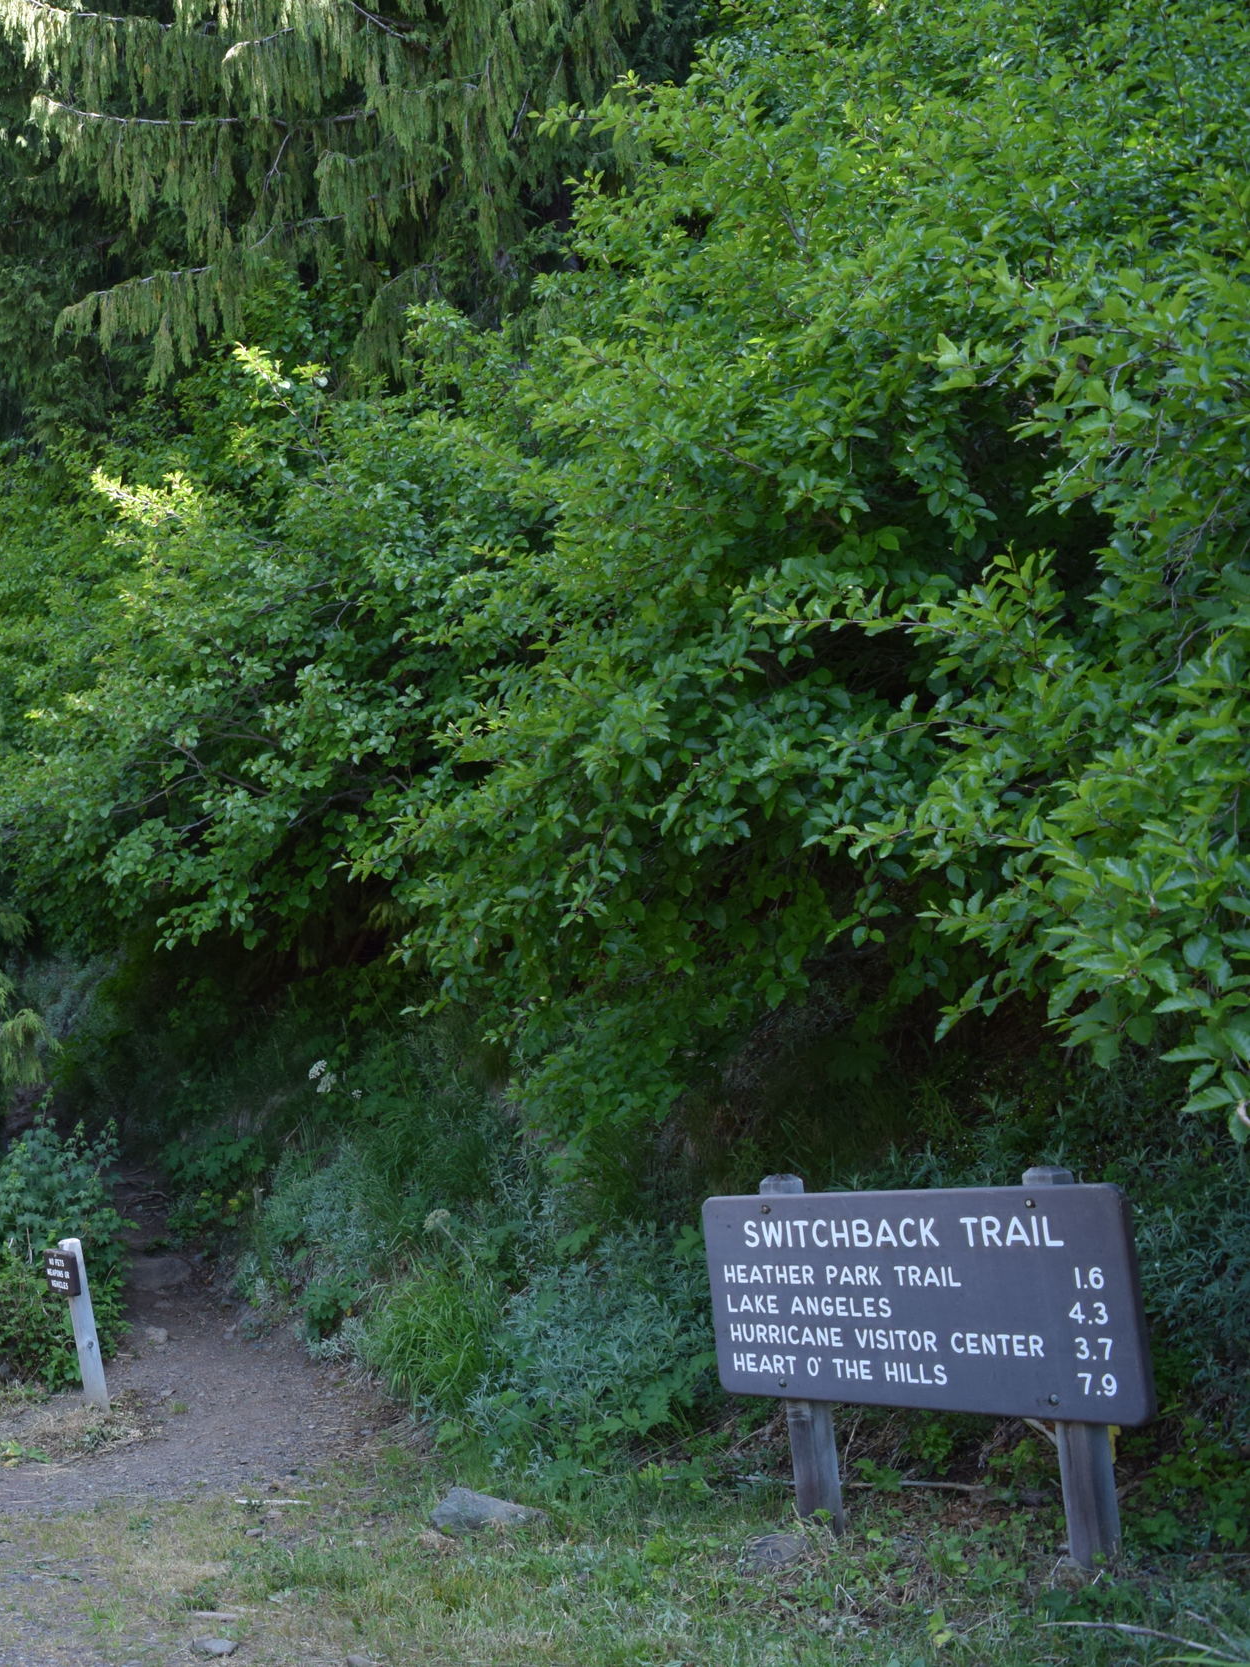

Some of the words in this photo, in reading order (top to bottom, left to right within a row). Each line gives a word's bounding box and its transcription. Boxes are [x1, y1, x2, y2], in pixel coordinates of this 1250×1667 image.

[743, 1217, 940, 1248] SWITCHBACK
[959, 1215, 1064, 1247] TRAIL
[47, 1268, 64, 1278] WEAPONS
[64, 1271, 70, 1279] OR
[55, 1258, 64, 1267] PETS
[51, 1279, 68, 1290] VEHICLES
[723, 1264, 815, 1285] HEATHER
[825, 1265, 882, 1286] PARK
[893, 1265, 962, 1287] TRAIL
[1074, 1266, 1104, 1290] 1.6
[726, 1294, 780, 1314] LAKE
[790, 1295, 892, 1318] ANGELES
[1068, 1301, 1109, 1325] 4.3
[729, 1323, 844, 1347] HURRICANE
[854, 1328, 938, 1353] VISITOR
[950, 1332, 1045, 1358] CENTER
[1074, 1336, 1113, 1361] 3.7
[733, 1352, 797, 1375] HEART
[806, 1356, 822, 1377] O'
[831, 1358, 873, 1381] THE
[884, 1361, 948, 1386] HILLS
[1077, 1372, 1117, 1397] 7.9
